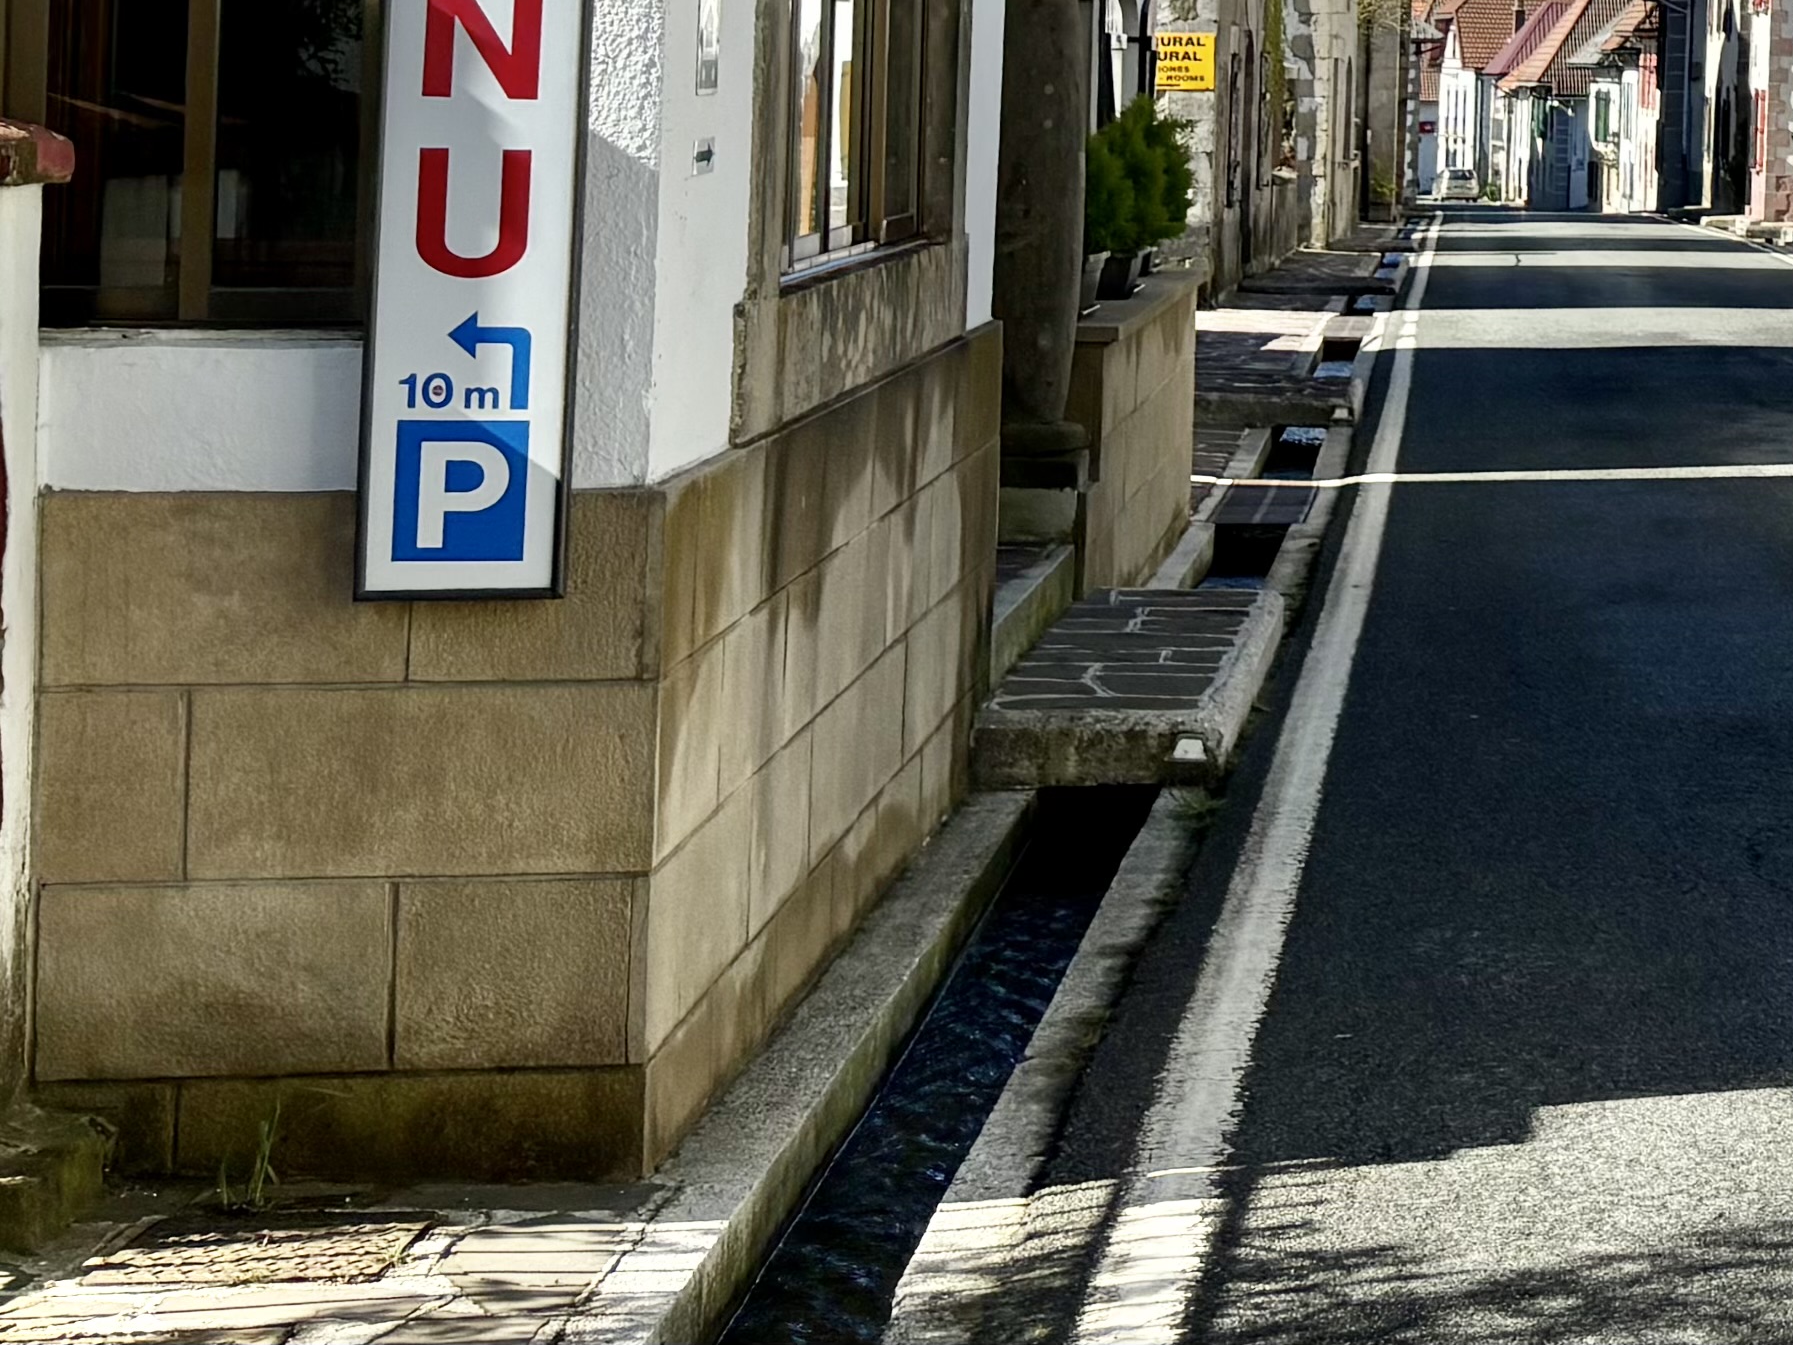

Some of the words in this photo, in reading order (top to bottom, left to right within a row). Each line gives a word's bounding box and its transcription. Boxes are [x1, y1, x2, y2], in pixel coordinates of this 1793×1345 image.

[398, 372, 454, 409] 10
[464, 386, 500, 409] m
[416, 441, 511, 549] P
